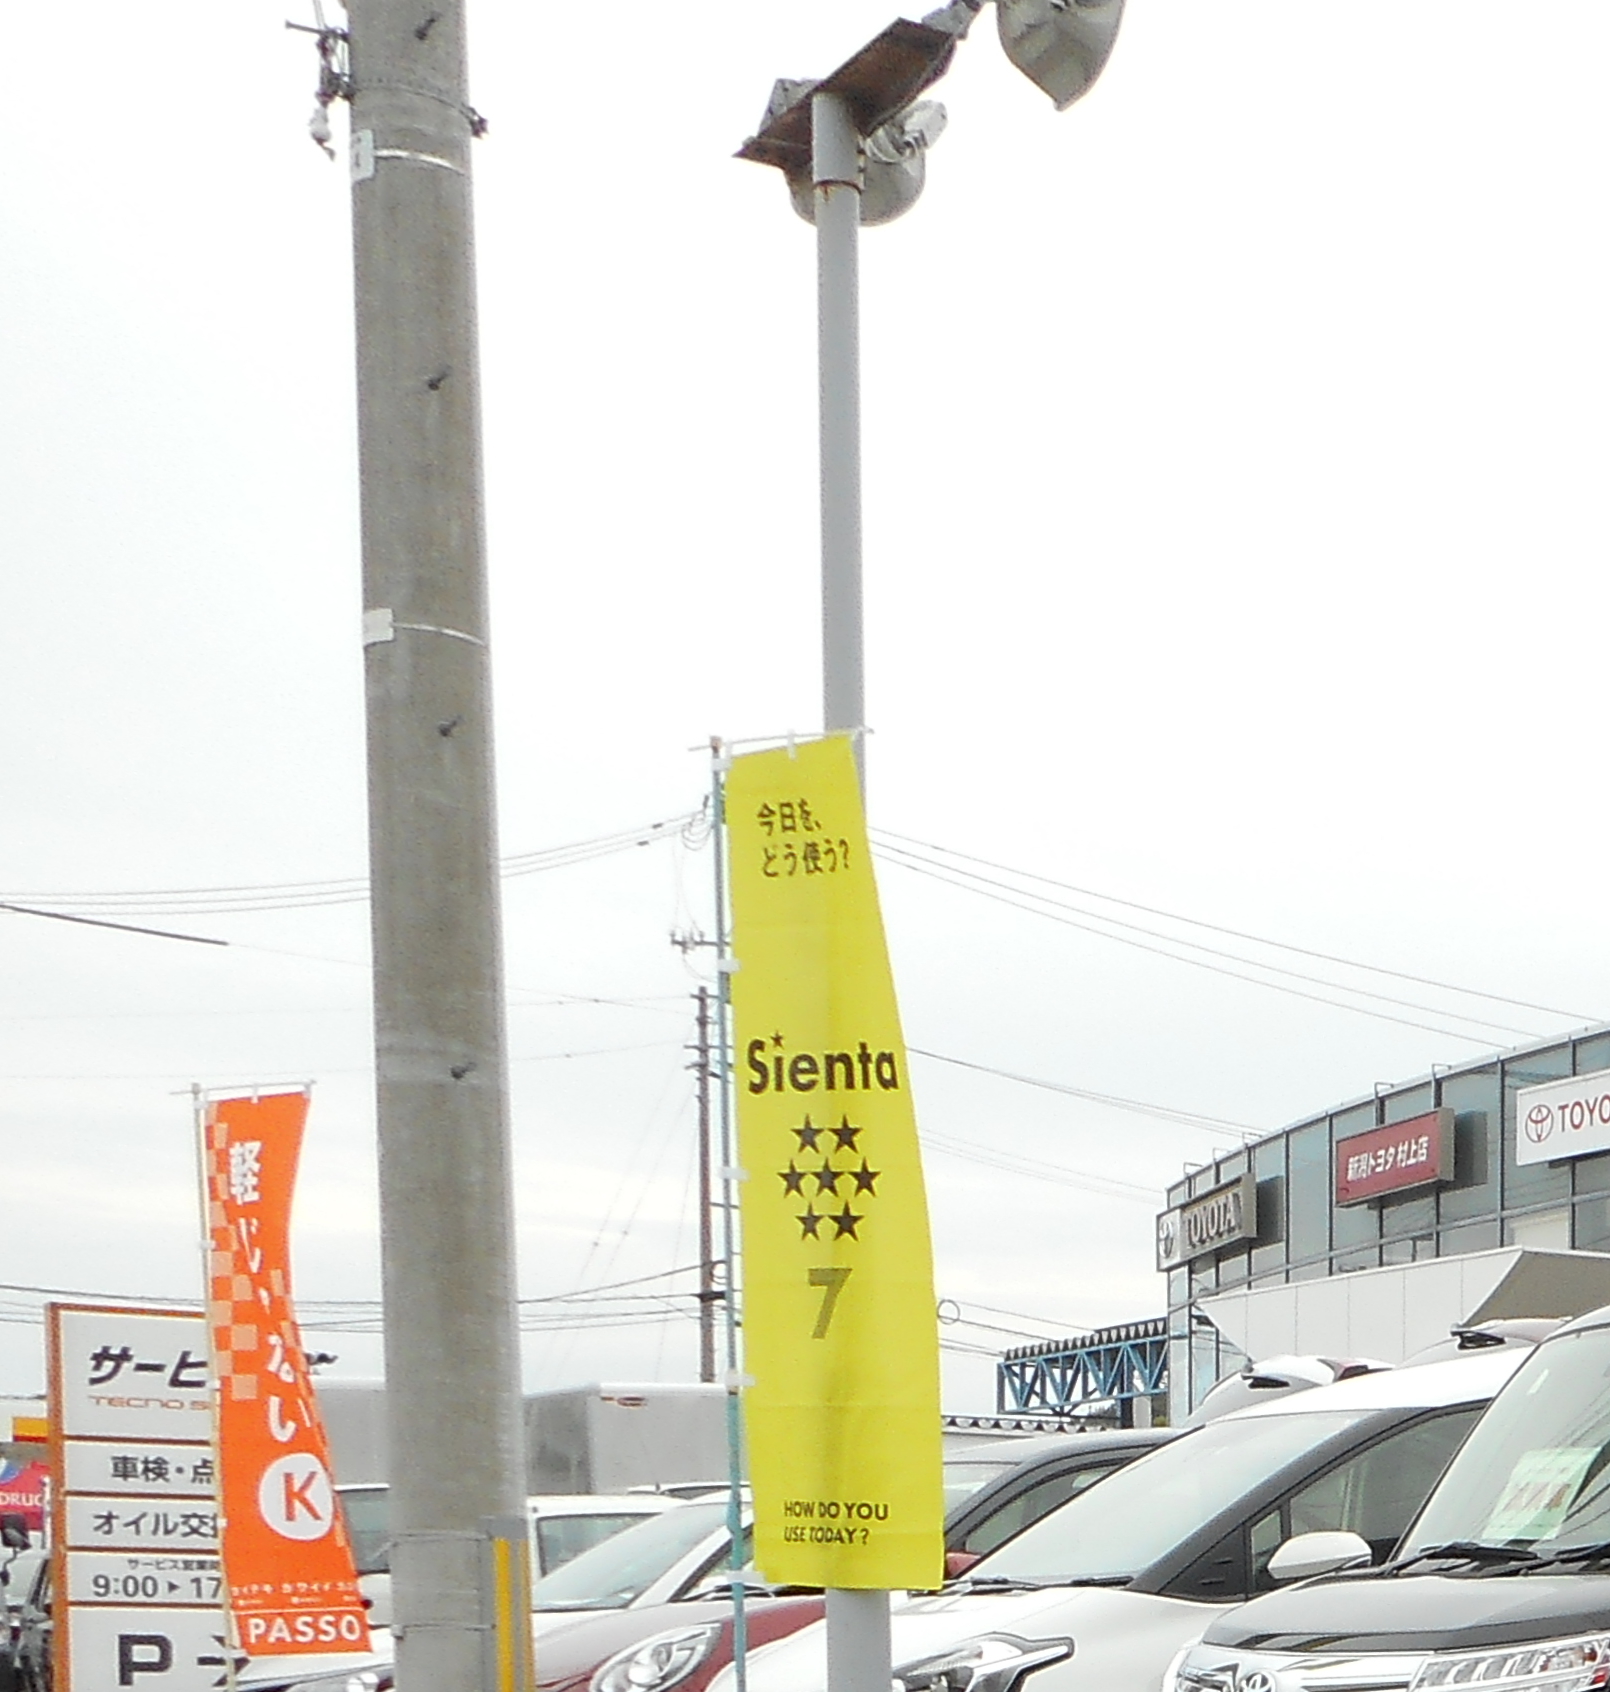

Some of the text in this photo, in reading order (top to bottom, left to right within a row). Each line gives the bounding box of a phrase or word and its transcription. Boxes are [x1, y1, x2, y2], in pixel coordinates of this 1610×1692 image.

[747, 1030, 899, 1096] Sienta
[807, 1267, 854, 1340] 7
[784, 1500, 889, 1521] HOW DO YOU
[784, 1525, 806, 1543] USE
[248, 1614, 361, 1644] PASSO
[117, 1634, 173, 1687] P
